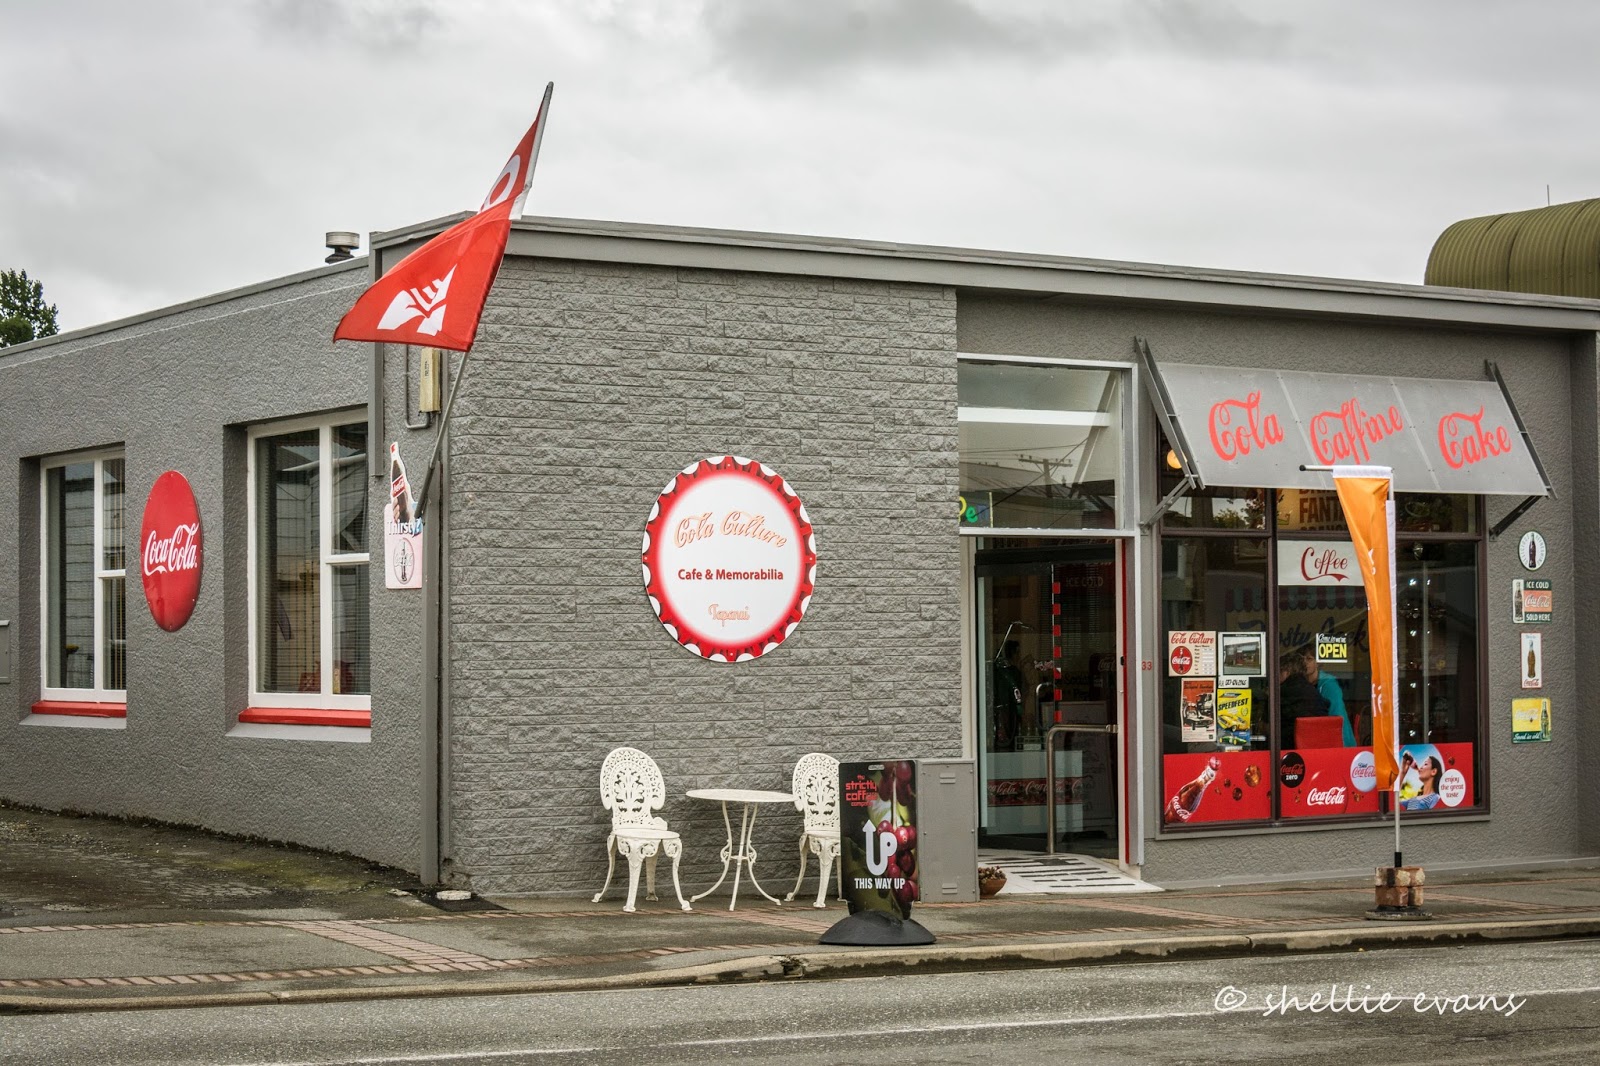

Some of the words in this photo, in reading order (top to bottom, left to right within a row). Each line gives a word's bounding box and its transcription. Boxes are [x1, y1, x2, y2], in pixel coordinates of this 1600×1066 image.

[1208, 390, 1284, 461] Cola
[1309, 398, 1403, 466] Caffine
[1437, 405, 1512, 470] Cake
[674, 511, 714, 548] Cola
[720, 508, 787, 548] Culture
[1301, 547, 1349, 582] Coffee
[677, 568, 703, 580] Cafe
[704, 569, 714, 580] &
[716, 568, 784, 580] Memorabilia
[708, 603, 750, 627] Tapanui
[1526, 613, 1538, 621] SOLD
[1538, 613, 1551, 621] HERE
[1170, 632, 1187, 644] Cola
[1188, 632, 1214, 644] Culture
[1318, 643, 1347, 658] OPEN
[1141, 661, 1152, 670] 33
[1218, 698, 1249, 711] SPEEDFEST
[1444, 774, 1459, 783] enjoy
[845, 780, 877, 792] strictly
[845, 789, 878, 801] coffee
[1307, 786, 1347, 807] Coca-Cola
[854, 878, 873, 890] THIS
[874, 878, 892, 890] WAY
[894, 878, 906, 890] UP
